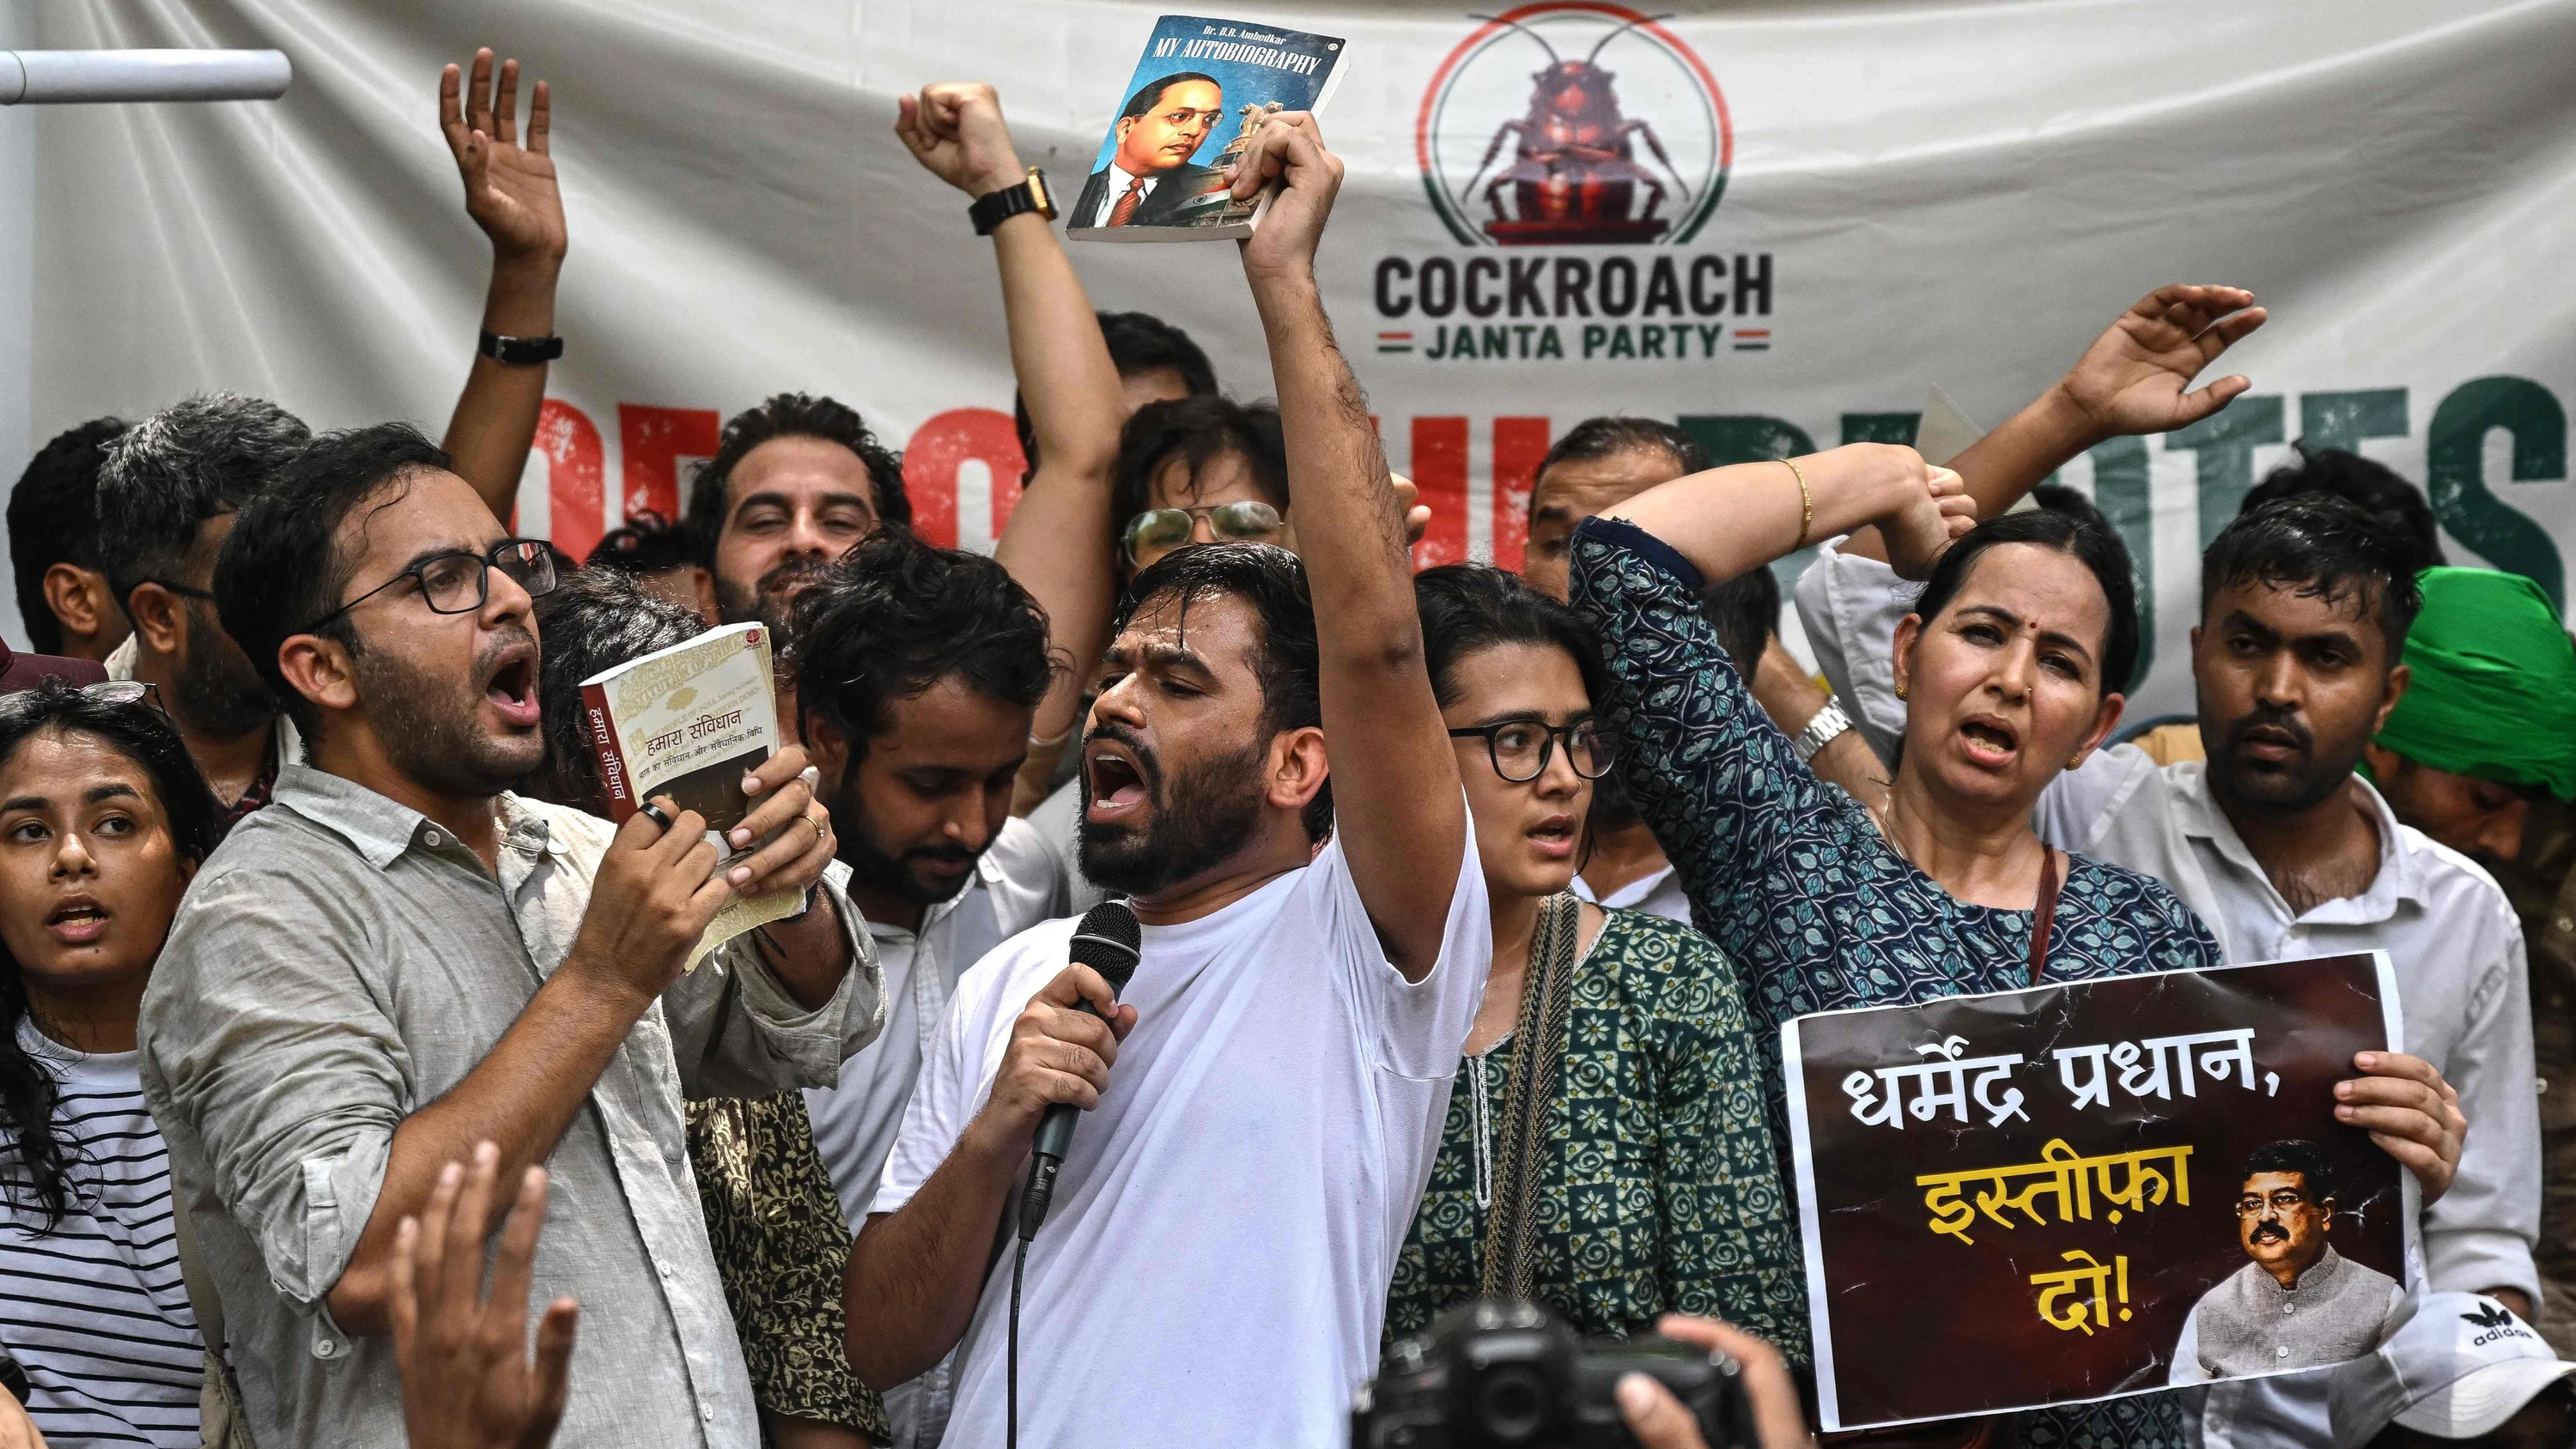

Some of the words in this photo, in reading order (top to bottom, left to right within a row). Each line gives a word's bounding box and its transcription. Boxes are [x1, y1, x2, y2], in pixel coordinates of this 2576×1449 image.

[1152, 38, 1183, 58] MY
[1180, 39, 1323, 76] AUTOBIOGRAPHY
[1202, 25, 1217, 36] Dr.
[1219, 27, 1236, 38] B.R.
[1238, 30, 1287, 45] Ambedkar
[1375, 253, 1773, 318] COCKROACH
[1425, 324, 1564, 361] JANTA
[1582, 324, 1724, 360] PARTY
[589, 707, 610, 745] हमारा
[602, 749, 626, 799] संविधान
[646, 729, 683, 756] हमारा
[689, 710, 742, 738] संविधान
[653, 761, 661, 772] का
[664, 751, 690, 767] संविधान
[695, 745, 708, 757] और
[711, 732, 744, 751] संवैधानिक
[747, 725, 762, 739] विधि
[1841, 1035, 2031, 1131] धर्मेंद्र
[2052, 1028, 2281, 1112] प्रधान,
[1917, 1138, 2193, 1245] इस्तीफ़ा
[2030, 1251, 2134, 1336] दो!
